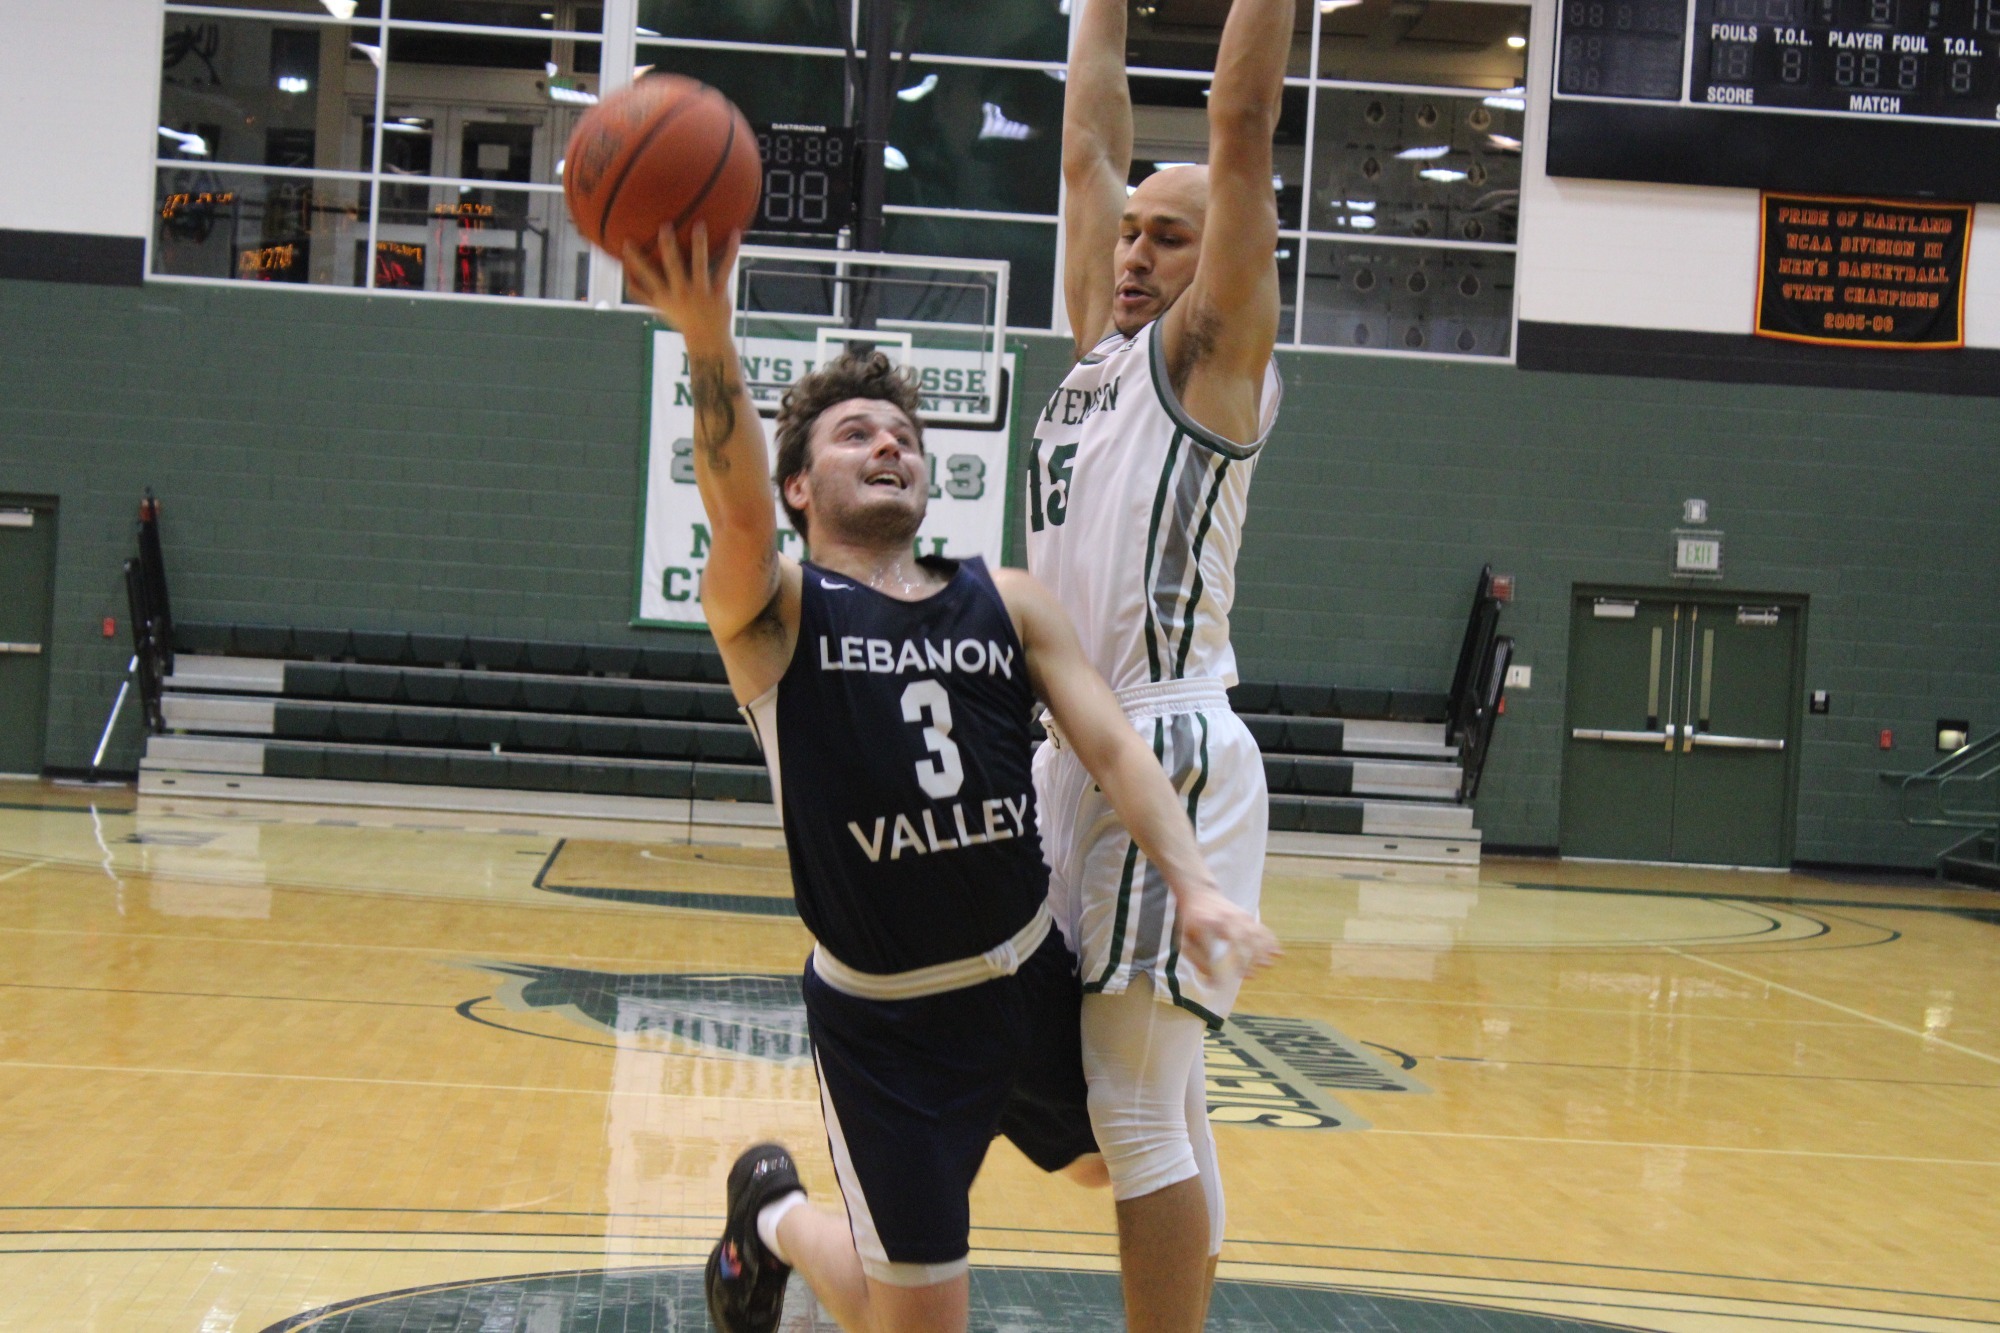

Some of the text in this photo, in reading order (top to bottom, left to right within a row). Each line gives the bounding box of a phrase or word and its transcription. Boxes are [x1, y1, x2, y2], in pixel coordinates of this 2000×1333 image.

[1711, 24, 1982, 56] FOULS T.O.L. PLAYER FOUL T.O.L.
[1707, 86, 1754, 104] SCORE
[1850, 95, 1900, 114] MATCH
[1779, 207, 1953, 234] PRIDE OF MARYLAND
[1786, 233, 1944, 259] NCAA DIVISION III
[1779, 257, 1949, 284] MEN'S BASKETBALL
[1782, 283, 1940, 309] STATE CHAMPIONS
[1823, 312, 1895, 333] 2005-06
[1685, 543, 1713, 565] EXIT
[819, 635, 1014, 680] LEBANON
[900, 678, 965, 800] 3
[847, 793, 1028, 863] VALLEY
